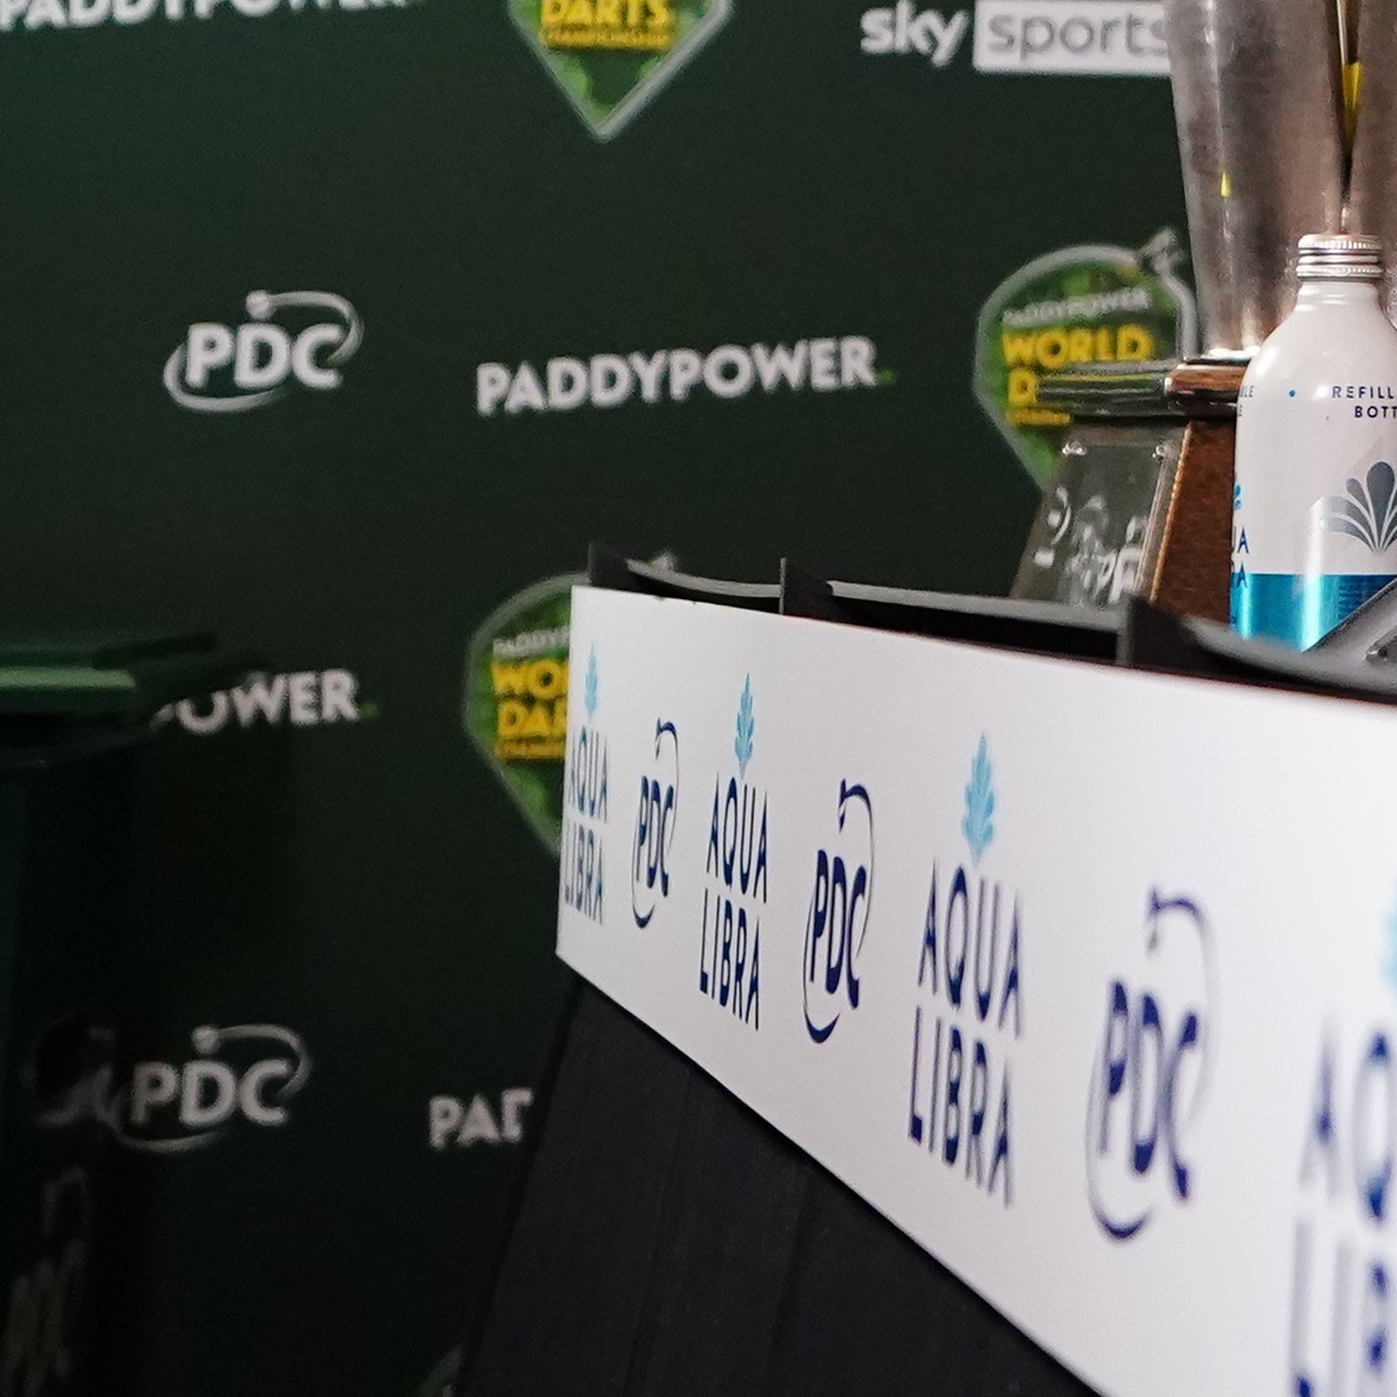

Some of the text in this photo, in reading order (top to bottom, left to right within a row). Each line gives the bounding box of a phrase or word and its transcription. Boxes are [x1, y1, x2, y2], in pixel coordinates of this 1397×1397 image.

[860, 0, 1171, 67] sky sports
[184, 323, 345, 389] PDC
[1002, 324, 1154, 369] WORLD
[568, 724, 608, 824] AQUA
[563, 820, 604, 925] LIBRA
[636, 776, 676, 899] PDC
[706, 773, 769, 905] AQUA
[699, 888, 761, 1032] LIBRA
[809, 849, 868, 1010] PDC
[918, 856, 1026, 1039] AQUA
[130, 1058, 290, 1127] PDC
[907, 1007, 1016, 1209] LIBRA
[1096, 977, 1199, 1202] PDC
